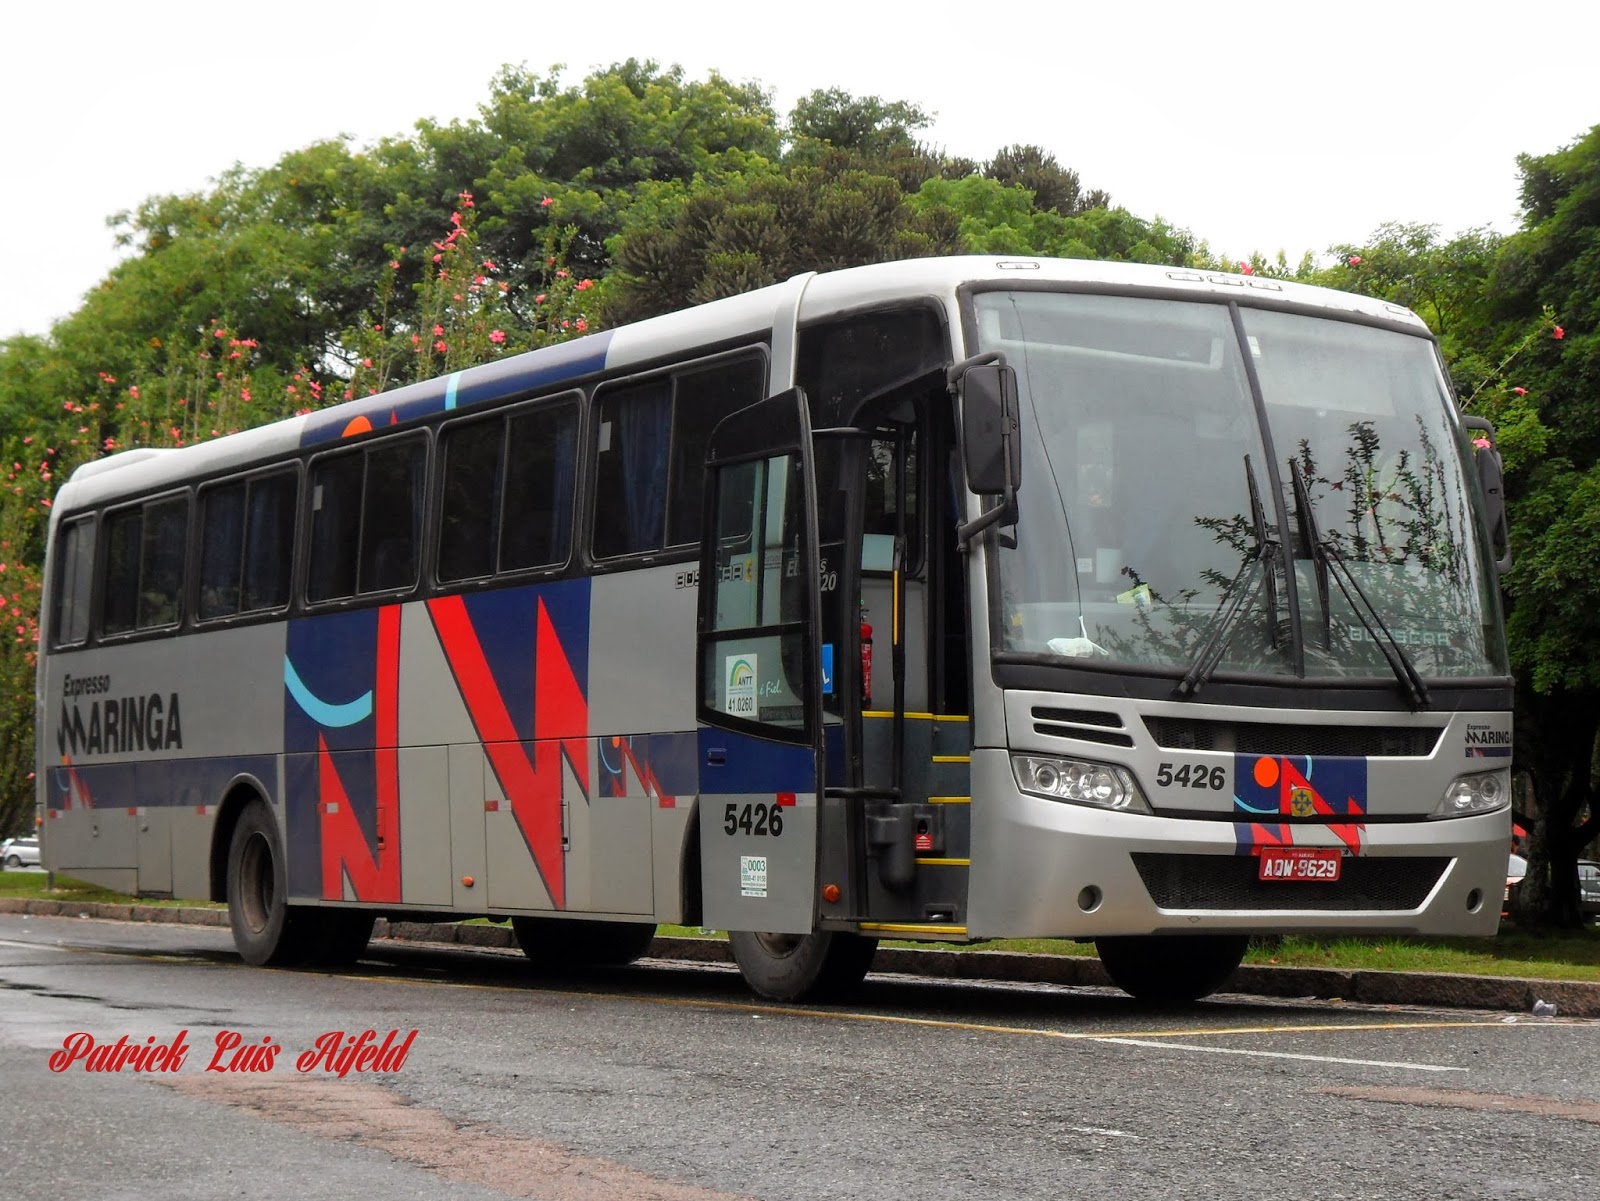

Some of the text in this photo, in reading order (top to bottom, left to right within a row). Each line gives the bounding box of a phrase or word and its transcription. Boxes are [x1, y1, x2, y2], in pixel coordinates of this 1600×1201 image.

[63, 674, 110, 701] Expresso
[738, 675, 753, 687] ANTT
[57, 692, 182, 756] MARINGA
[1156, 762, 1226, 791] 5426
[724, 803, 783, 837] 5426
[748, 860, 766, 872] 0003
